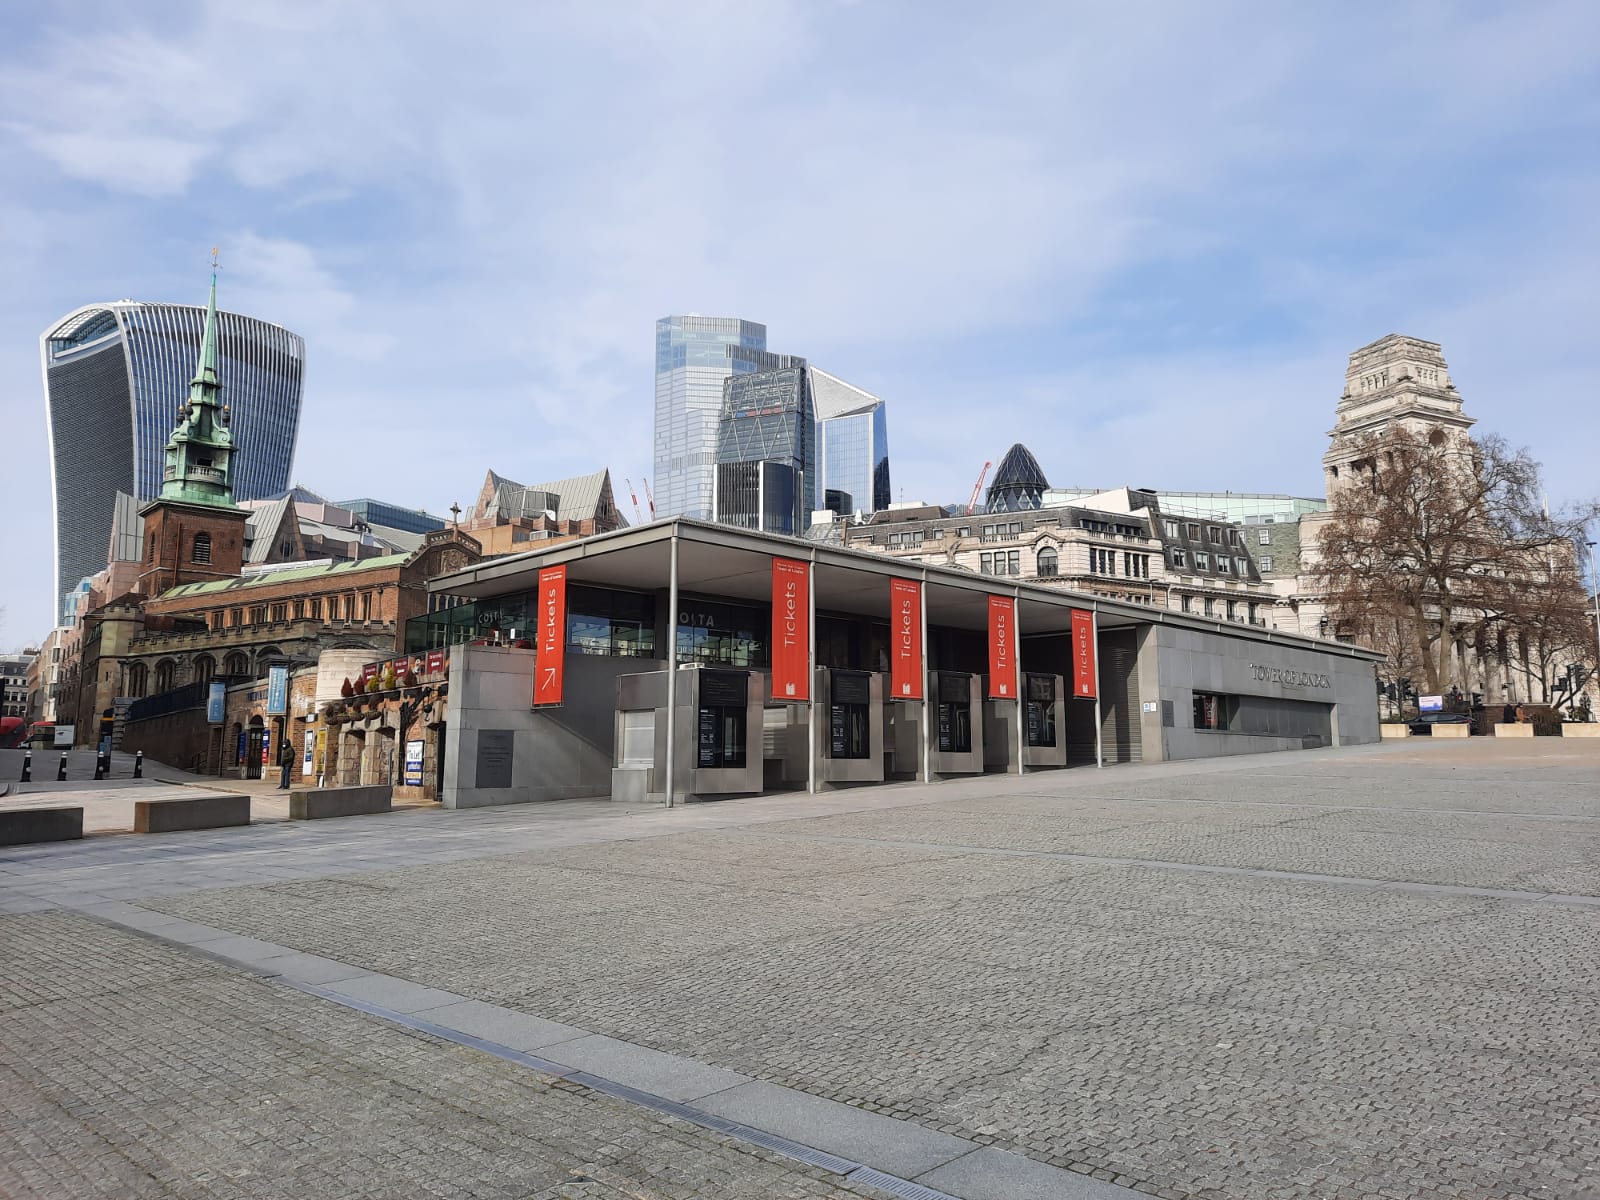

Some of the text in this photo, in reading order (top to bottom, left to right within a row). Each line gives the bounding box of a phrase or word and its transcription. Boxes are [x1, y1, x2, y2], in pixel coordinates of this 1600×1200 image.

[545, 588, 556, 656] Tickets
[680, 612, 714, 627] OSTA
[784, 582, 796, 649] Tickets
[901, 600, 911, 660] Tickets
[997, 615, 1007, 671] Tickets
[1080, 627, 1088, 677] Tickets
[1248, 663, 1283, 683] TOWER
[1296, 671, 1331, 688] LONDON
